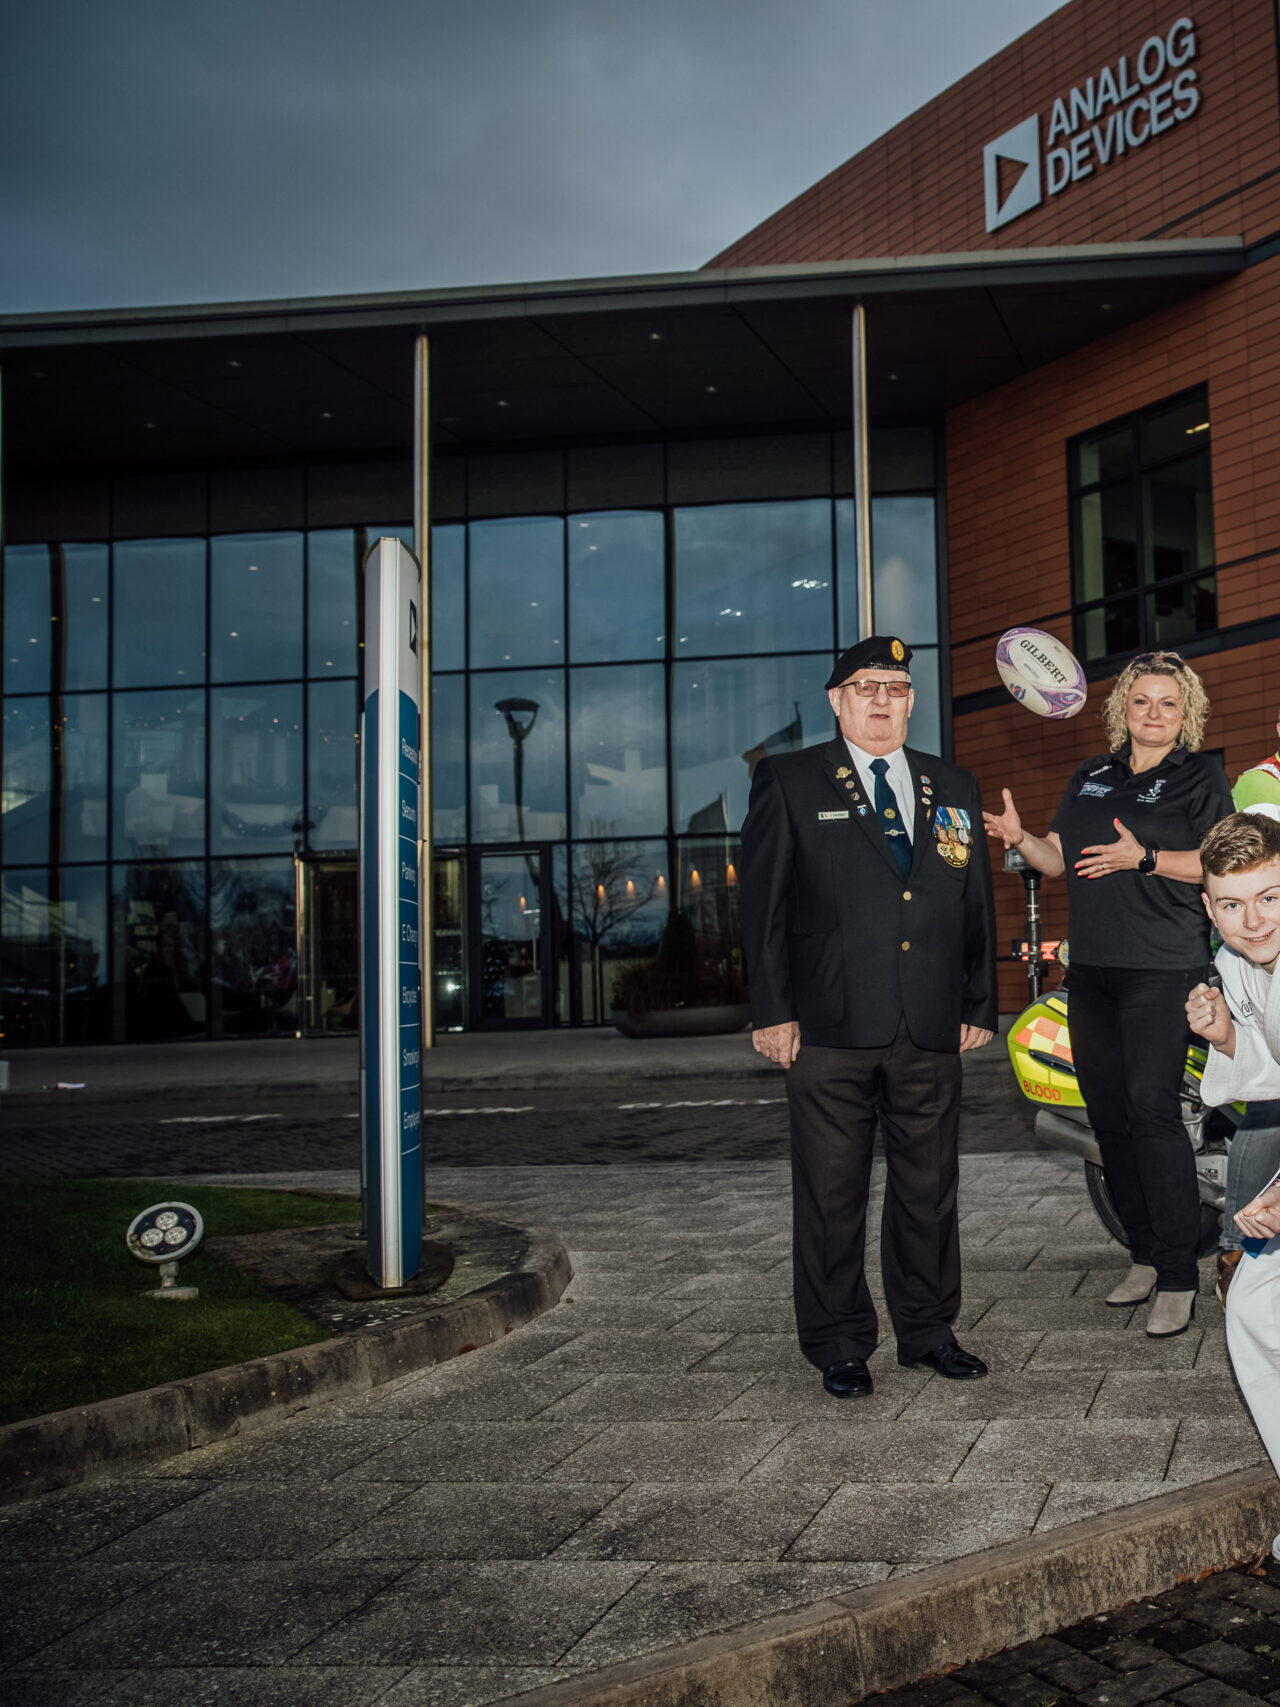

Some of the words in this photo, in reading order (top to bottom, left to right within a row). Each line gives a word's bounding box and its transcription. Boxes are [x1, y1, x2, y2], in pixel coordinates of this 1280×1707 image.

[1047, 17, 1196, 147] ANALOG
[1046, 69, 1199, 196] DEVICES
[1020, 639, 1068, 684] GILBERT
[1023, 1080, 1062, 1102] BLOOD
